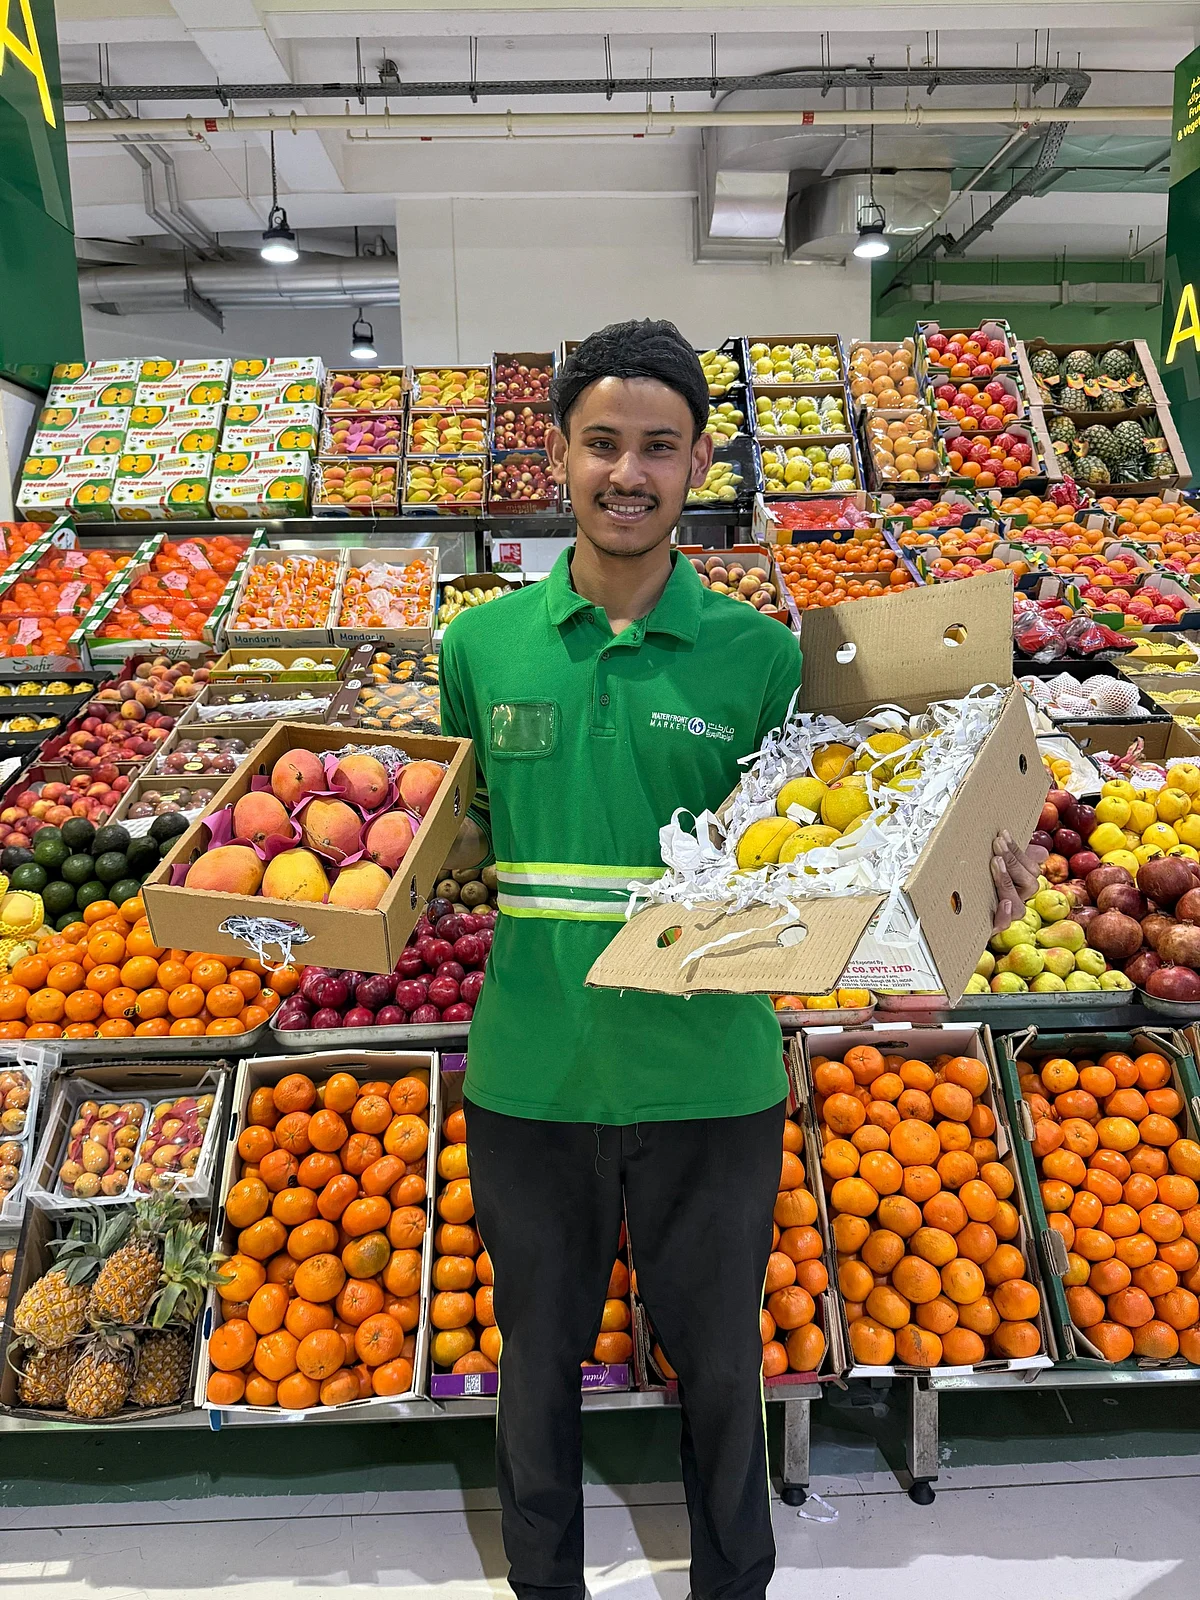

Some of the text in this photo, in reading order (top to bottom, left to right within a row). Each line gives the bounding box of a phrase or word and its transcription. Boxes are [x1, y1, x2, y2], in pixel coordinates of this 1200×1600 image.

[234, 635, 280, 644] Mandarin
[340, 634, 385, 642] Mandarin
[149, 641, 190, 659] Safir
[13, 657, 54, 672] Safir
[652, 712, 688, 724] WATERFRONT
[650, 720, 686, 731] MARKET
